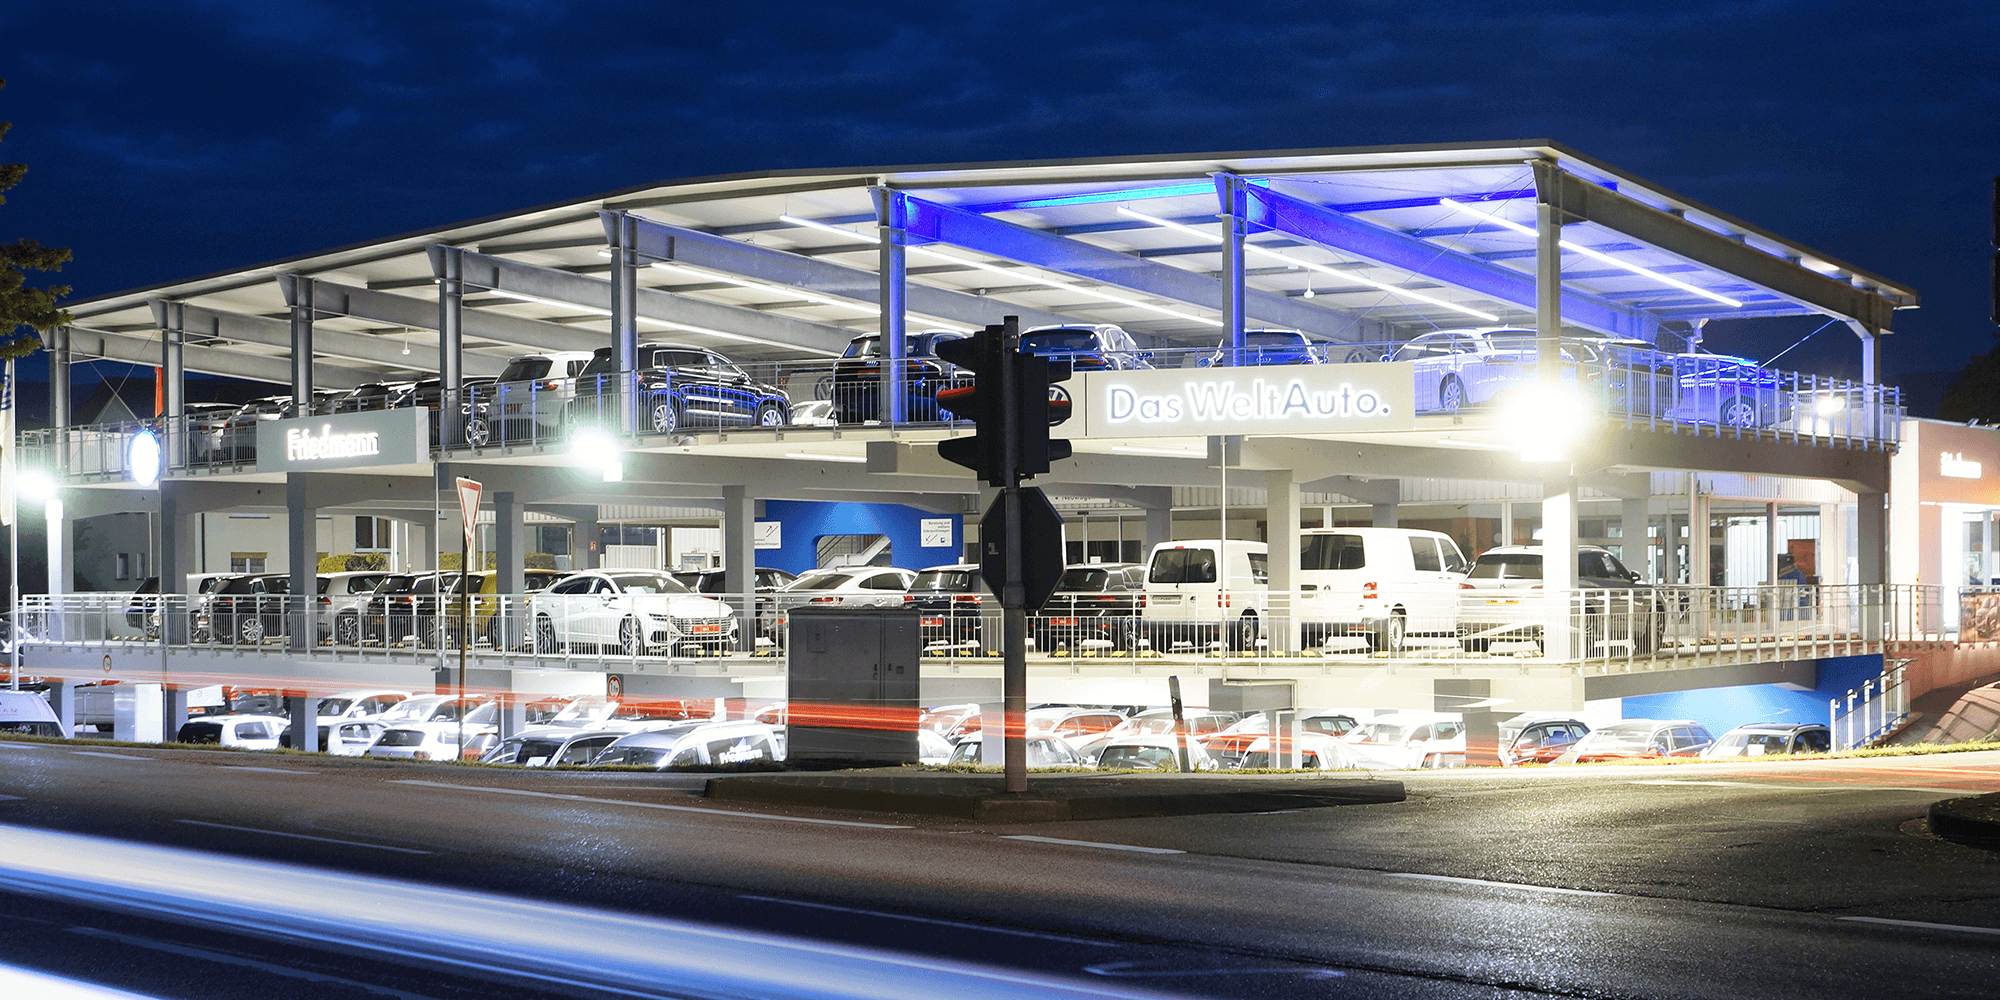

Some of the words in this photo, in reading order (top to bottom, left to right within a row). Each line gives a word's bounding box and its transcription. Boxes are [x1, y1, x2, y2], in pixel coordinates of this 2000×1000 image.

[1108, 386, 1182, 421] Das
[1187, 380, 1390, 420] WeltAuto.
[287, 424, 380, 461] Friedmann
